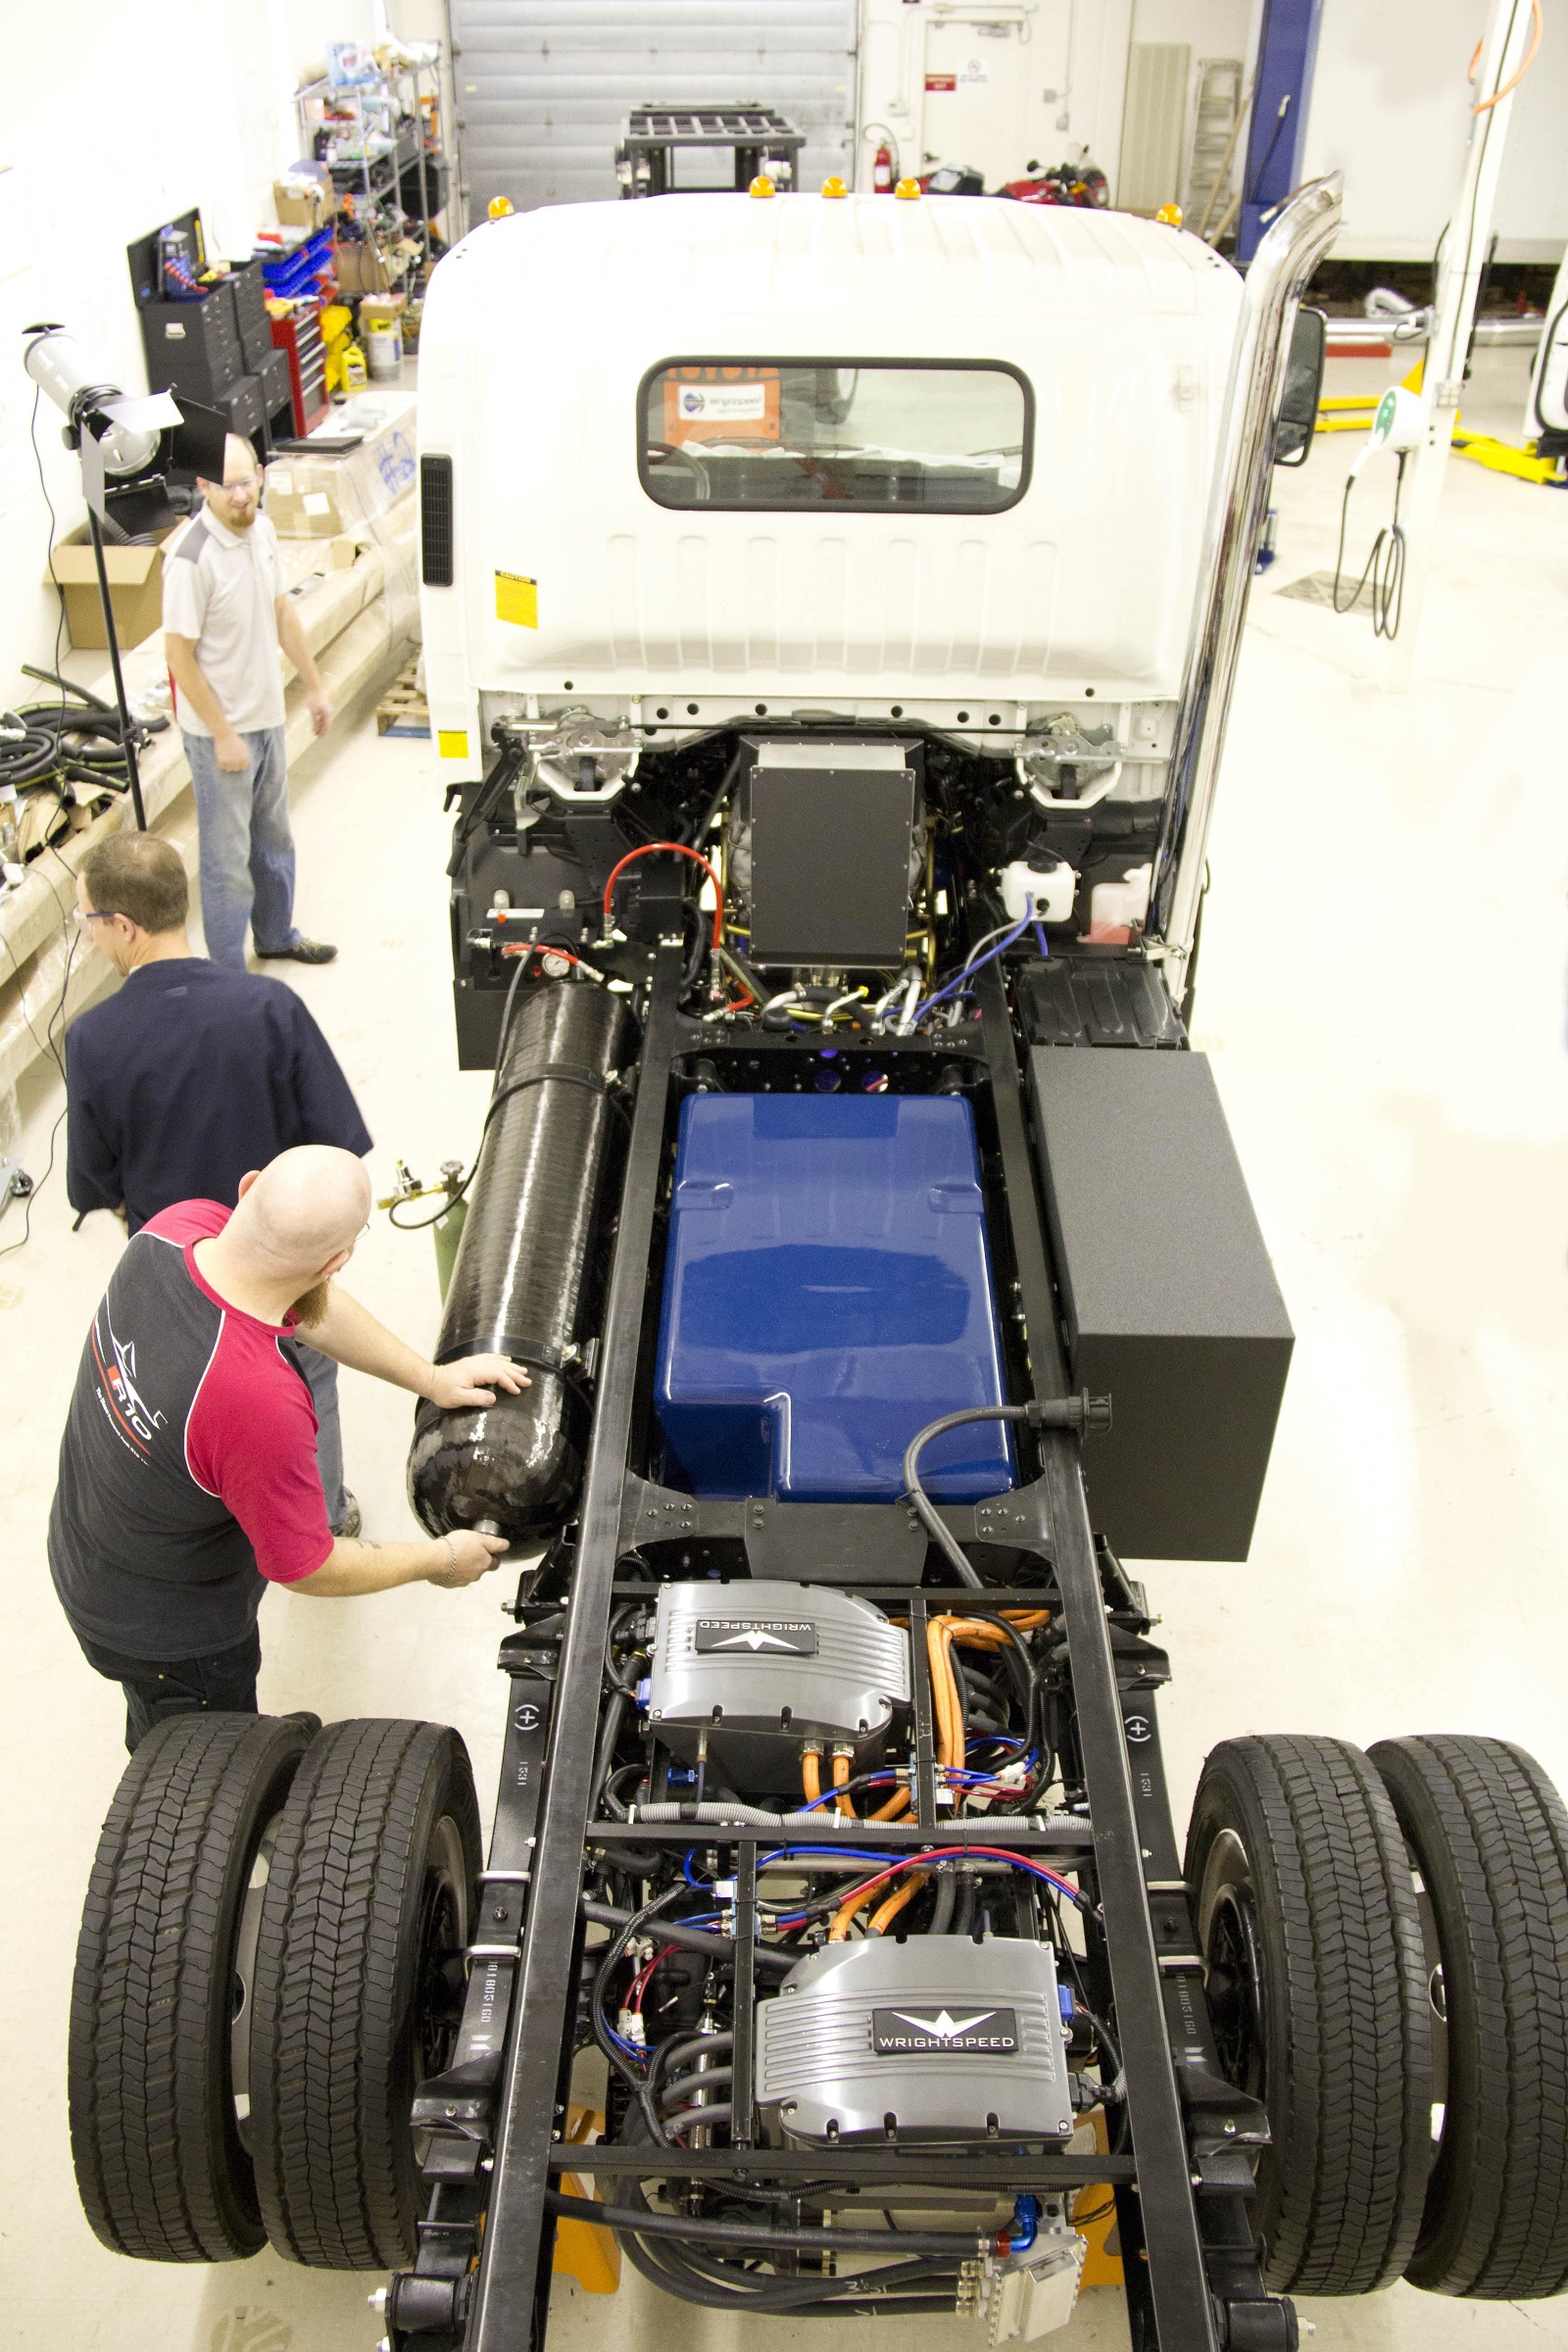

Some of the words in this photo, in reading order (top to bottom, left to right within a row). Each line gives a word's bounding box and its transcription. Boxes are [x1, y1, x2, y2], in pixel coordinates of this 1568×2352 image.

[112, 1378, 152, 1441] R10
[700, 1621, 811, 1632] WRIGHTSPEED
[880, 2037, 1014, 2047] WRIGHTSPEED
